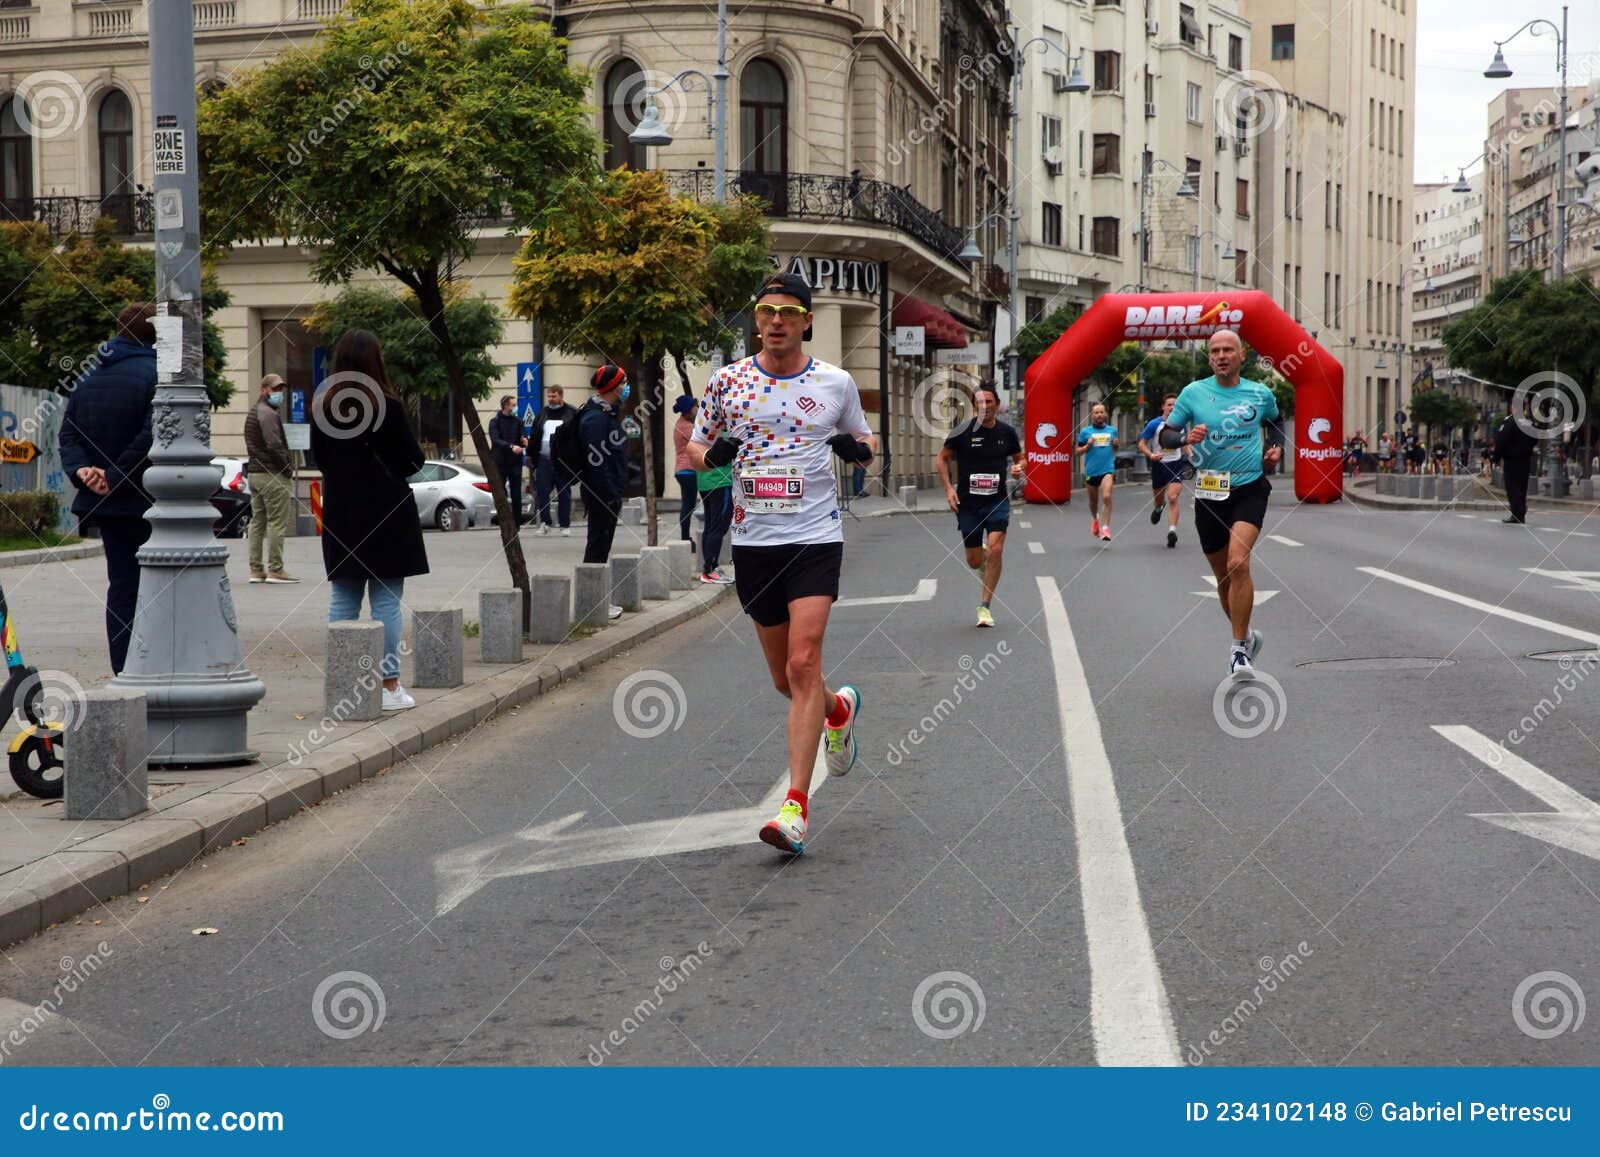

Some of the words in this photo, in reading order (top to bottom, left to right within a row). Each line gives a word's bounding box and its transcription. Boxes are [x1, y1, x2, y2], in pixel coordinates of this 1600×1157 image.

[155, 132, 182, 150] BNE
[155, 151, 183, 160] WAS
[156, 161, 183, 171] HERE
[1125, 305, 1203, 326] DARE
[1219, 309, 1243, 323] TO
[1028, 451, 1070, 465] Playtika
[1300, 446, 1342, 461] Playtika
